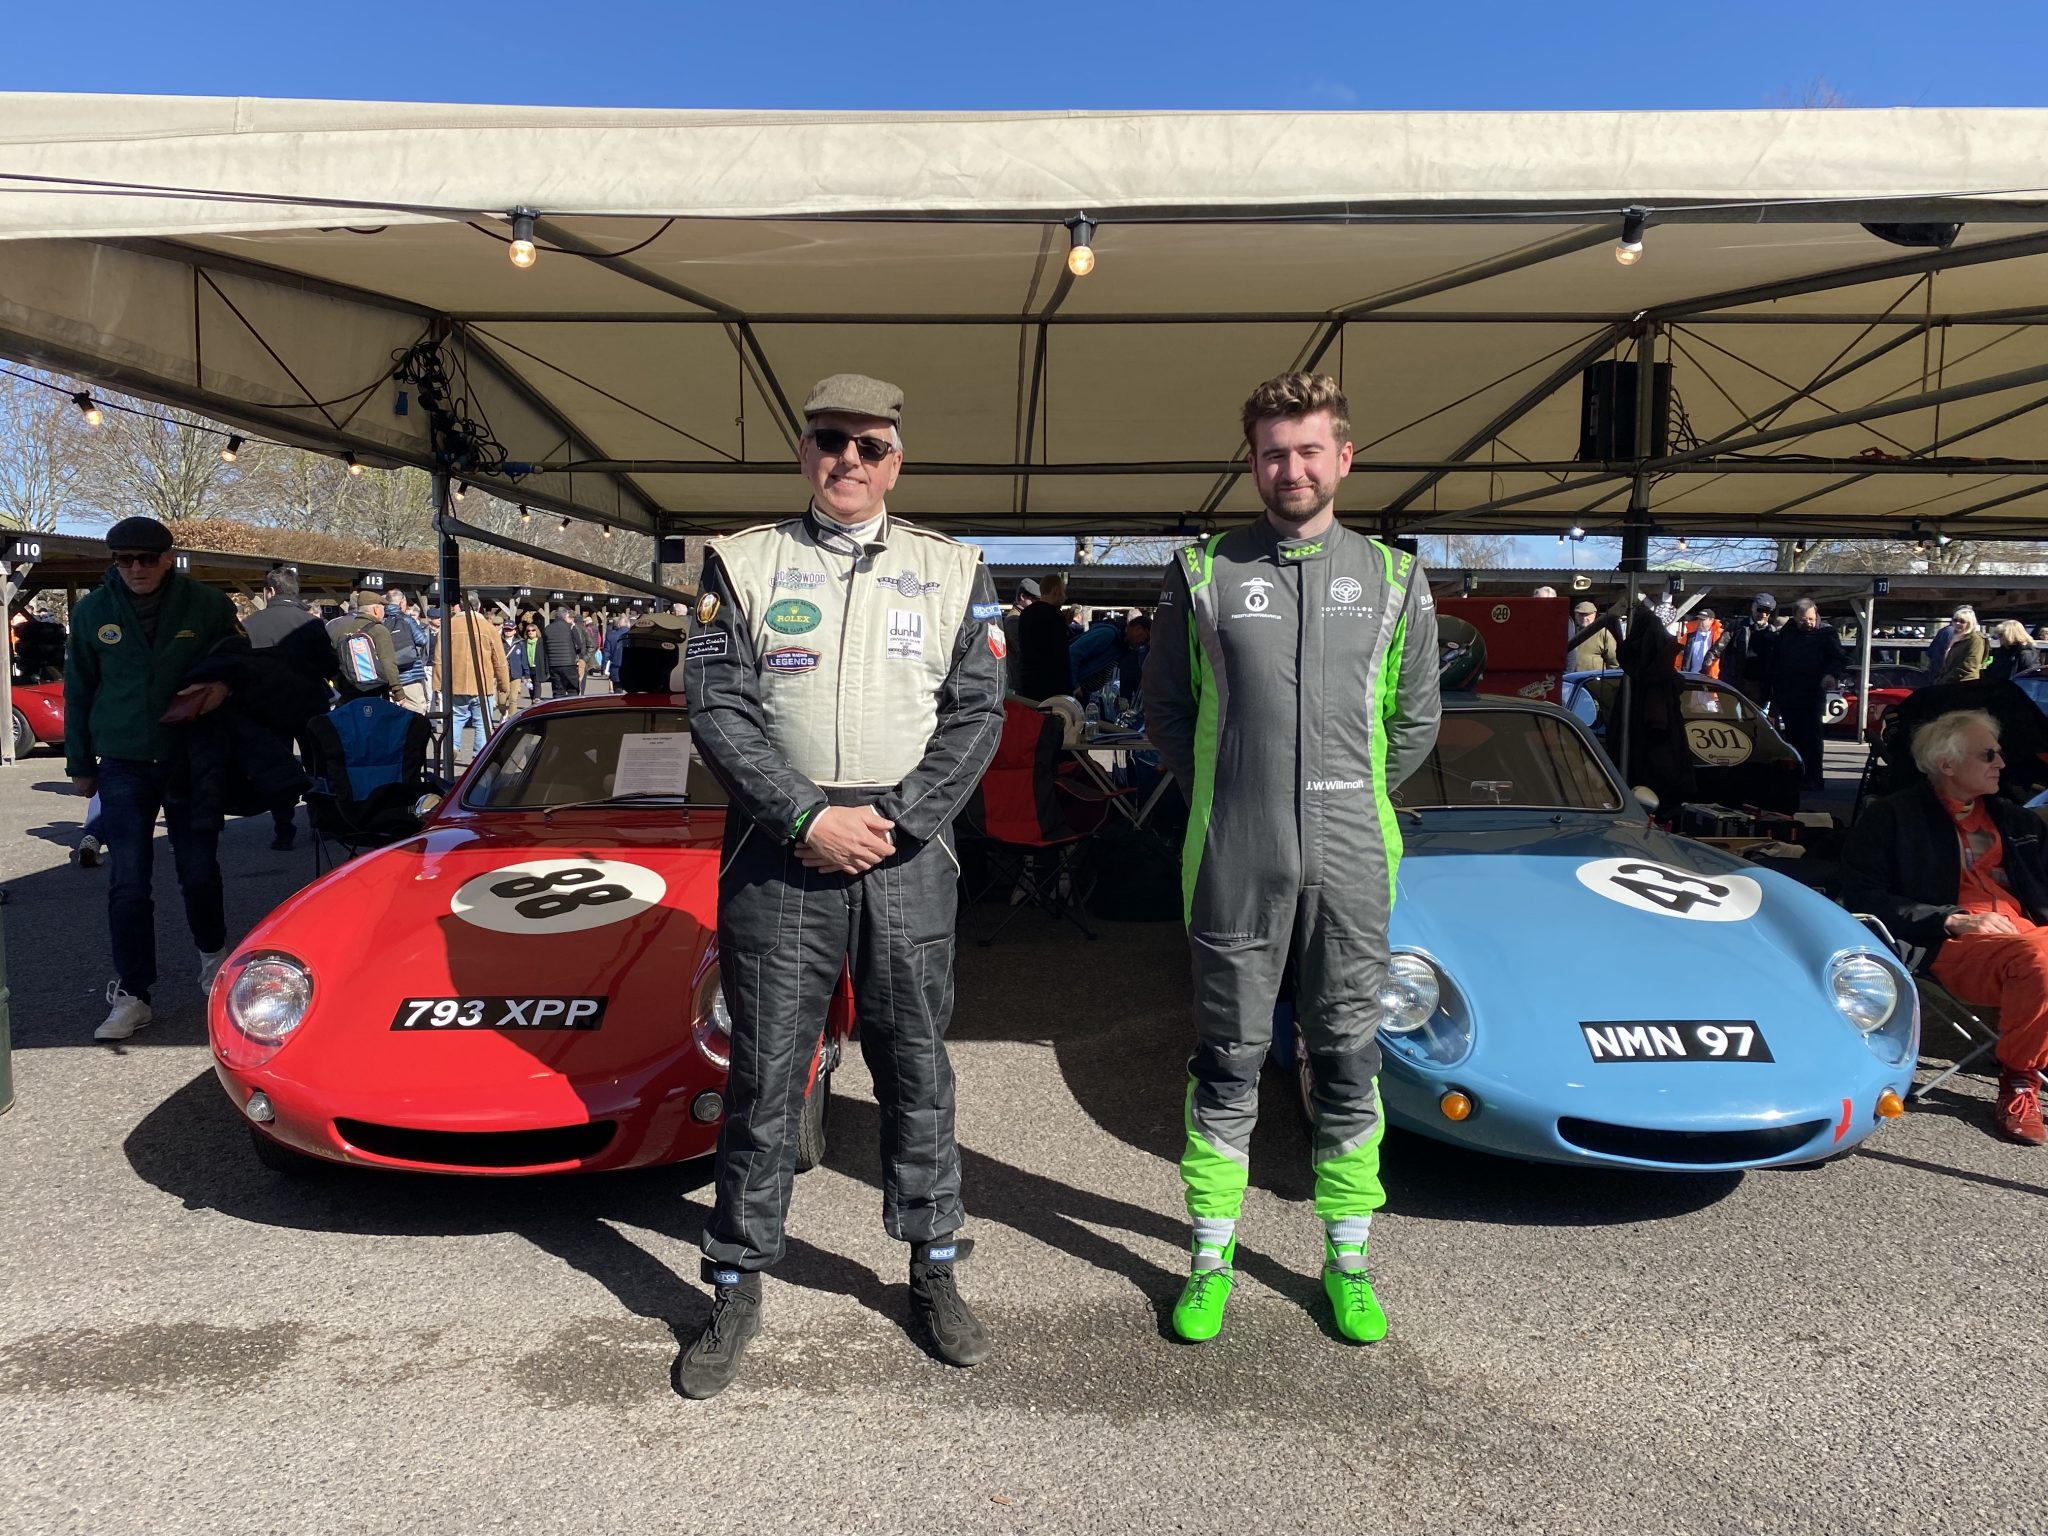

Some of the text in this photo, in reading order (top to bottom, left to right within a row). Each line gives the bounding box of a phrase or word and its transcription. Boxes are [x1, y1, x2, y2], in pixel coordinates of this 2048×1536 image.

[16, 542, 40, 557] 110
[366, 575, 383, 585] 113
[1673, 580, 1680, 589] 72
[1878, 582, 1887, 592] 73
[776, 615, 811, 623] ROLEX
[770, 657, 815, 666] LEGENDS
[1691, 728, 1747, 750] 301
[490, 867, 633, 919] 88
[1609, 863, 1730, 914] 43
[404, 1000, 599, 1027] 793 XPP
[1585, 1025, 1755, 1057] NMN 97
